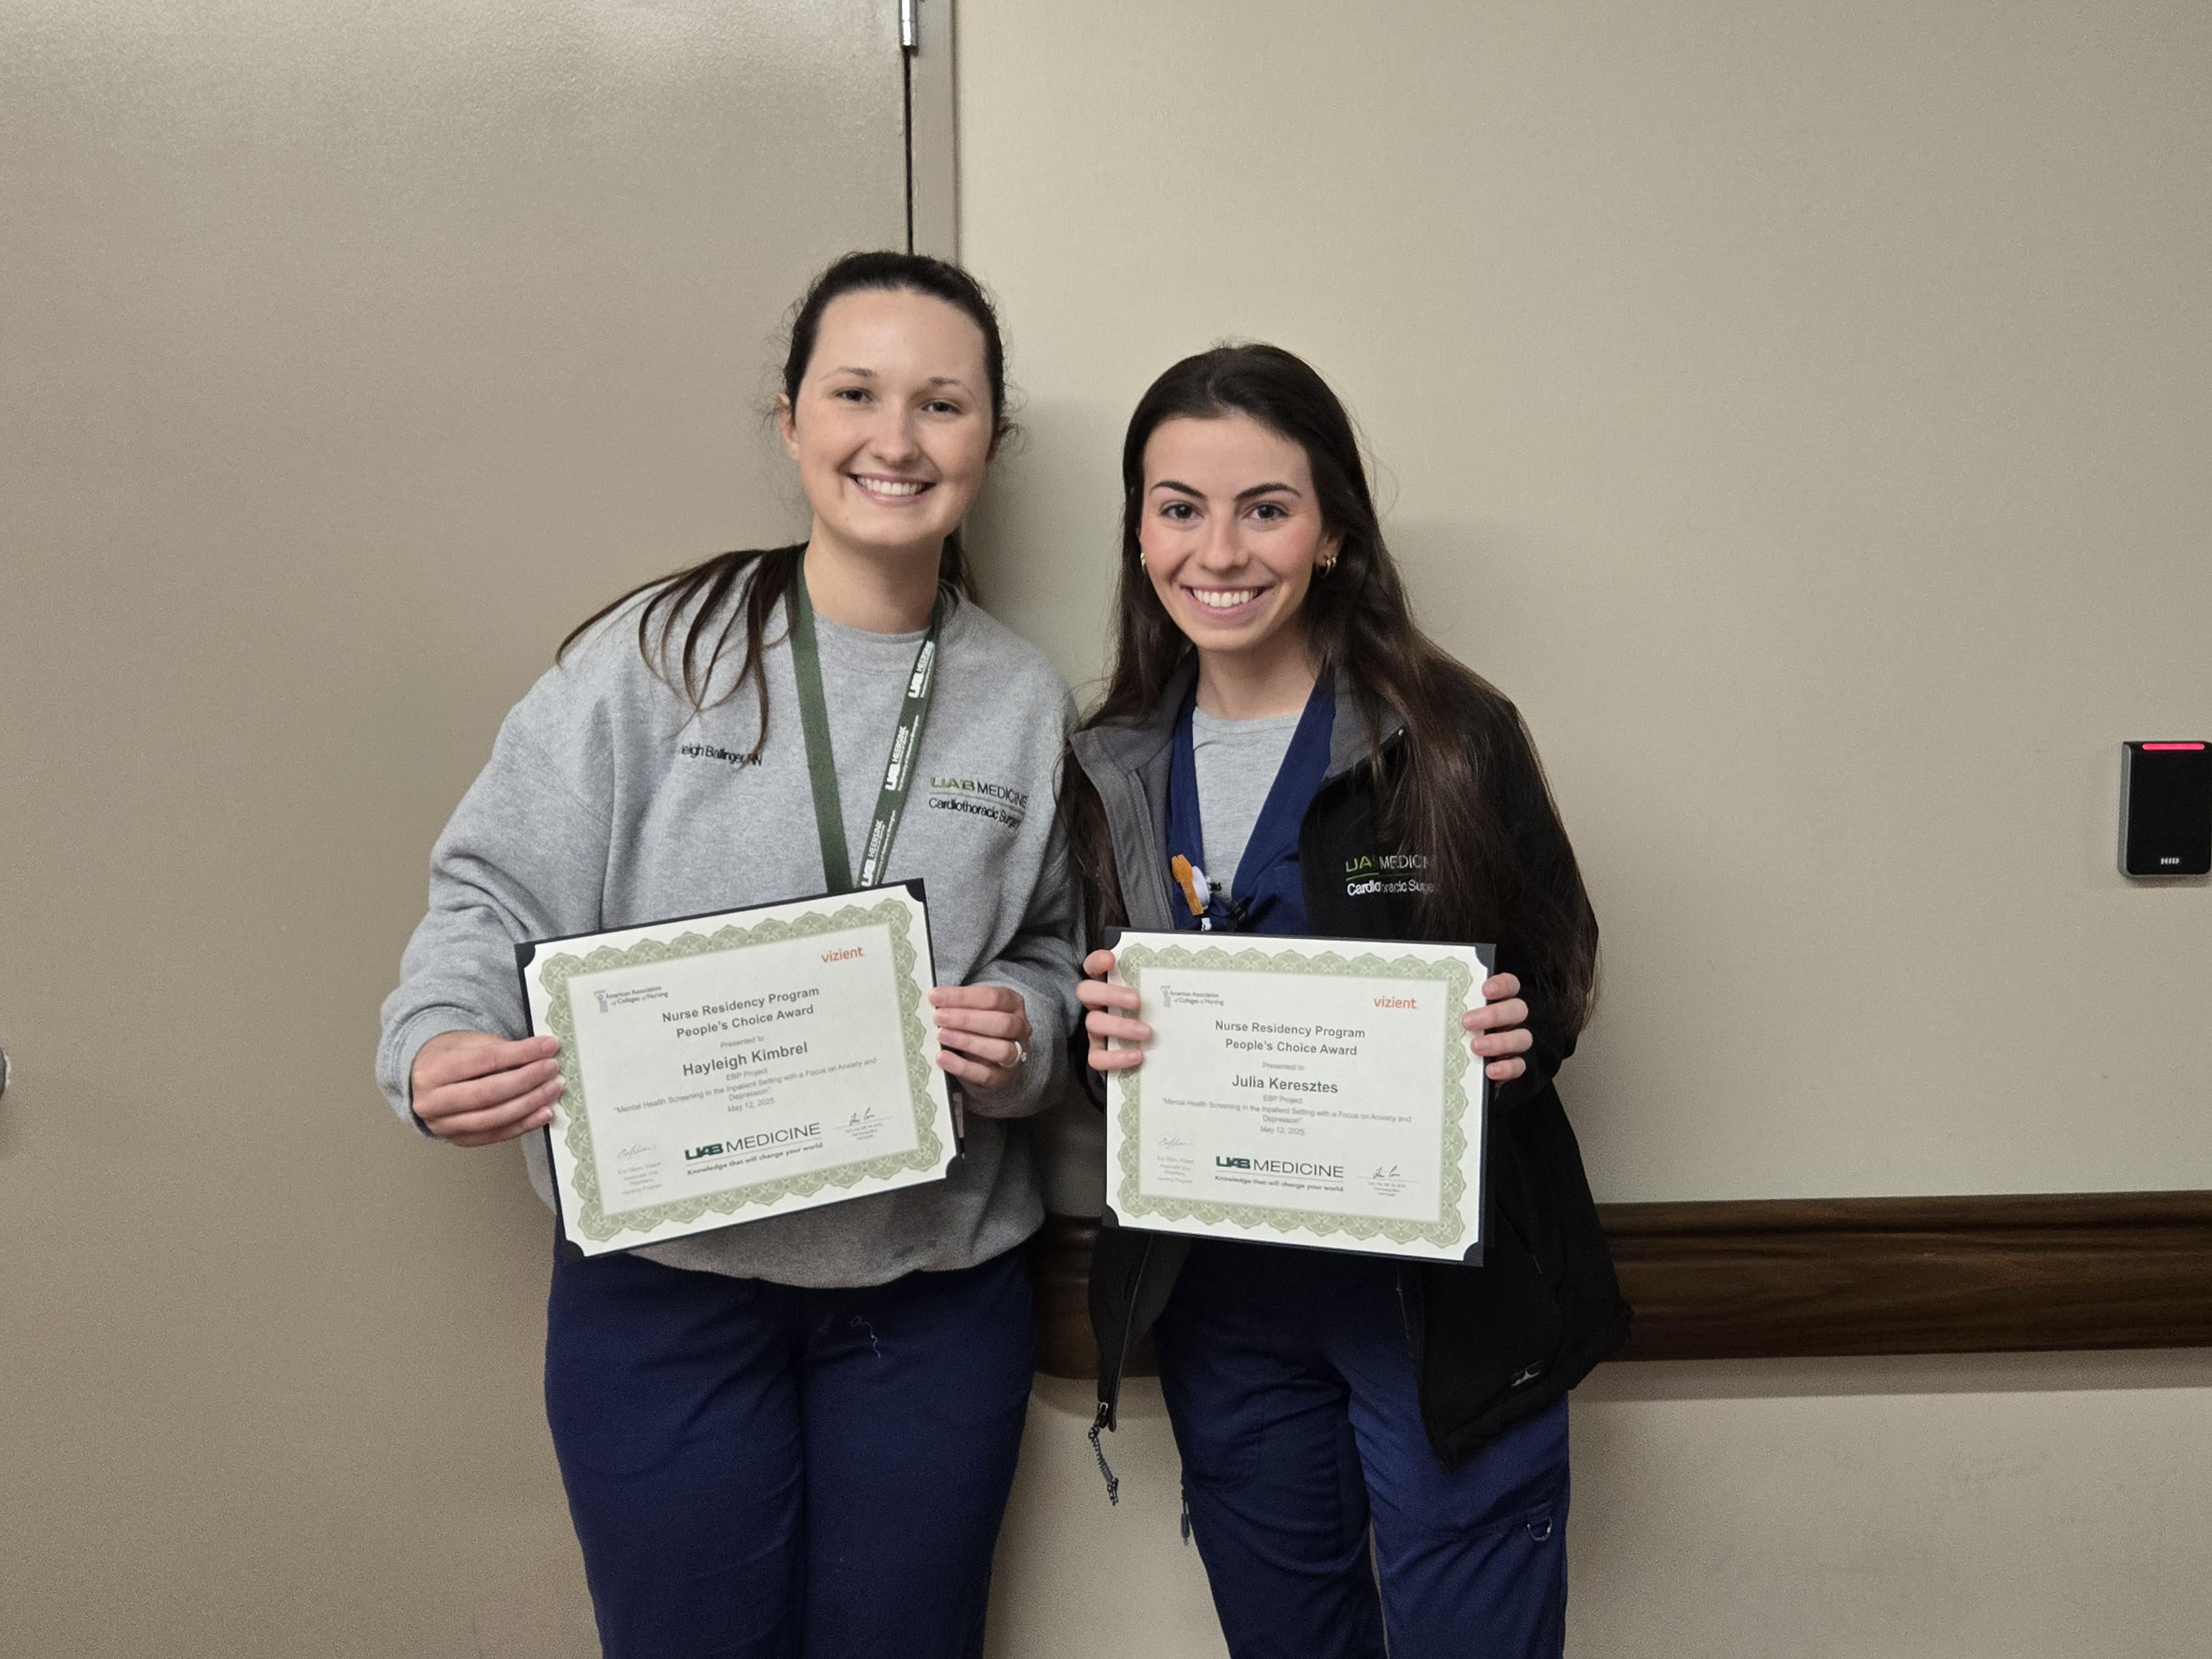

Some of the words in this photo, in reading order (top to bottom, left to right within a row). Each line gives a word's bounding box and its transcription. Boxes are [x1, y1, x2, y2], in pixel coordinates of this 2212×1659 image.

[908, 672, 924, 698] UAB
[885, 764, 900, 791] UAB
[930, 777, 975, 791] UAB
[977, 780, 1029, 808] MEDICINE
[929, 797, 999, 820] Cardiothoracic
[868, 820, 884, 857] HEERSINK
[861, 859, 876, 886] UAB
[821, 946, 864, 963] vizient
[662, 1009, 698, 1022] Nurse
[702, 998, 765, 1016] Residency
[769, 988, 819, 1004] Program
[1374, 996, 1416, 1009] vizient
[676, 1021, 728, 1038] People's
[732, 1013, 773, 1028] Choice
[776, 1004, 814, 1020] Award
[1215, 1020, 1248, 1032] Nurse
[1251, 1022, 1312, 1037] Residency
[1316, 1025, 1365, 1039] Program
[721, 1036, 756, 1048] Presented
[1225, 1038, 1273, 1052] People's
[1277, 1041, 1317, 1053] Choice
[1320, 1044, 1357, 1056] Award
[683, 1054, 747, 1076] Hayleigh
[752, 1041, 808, 1063] Kimbrel
[1262, 1061, 1296, 1071] Presented
[643, 1099, 666, 1108] Health
[668, 1092, 704, 1104] Screening
[727, 1081, 757, 1093] Inpatient
[758, 1076, 782, 1086] Setting
[784, 1072, 797, 1081] with
[806, 1068, 826, 1077] Focus
[838, 1061, 863, 1071] Anxiety
[864, 1057, 877, 1066] and
[726, 1072, 742, 1081] EBP
[743, 1067, 768, 1078] Project
[1232, 1074, 1264, 1088] Julia
[1269, 1077, 1338, 1093] Keresztes
[728, 1104, 744, 1113] May
[758, 1097, 775, 1107] 2025
[1279, 1095, 1303, 1105] Project
[1209, 1101, 1240, 1112] Screening
[1262, 1105, 1290, 1115] Inpatient
[1291, 1108, 1315, 1117] Setting
[1370, 1113, 1396, 1123] Anxiety
[684, 1143, 724, 1161] UAB
[726, 1122, 821, 1152] MEDICINE
[1288, 1127, 1305, 1135] 2025
[687, 1163, 727, 1176] Knowledge
[729, 1159, 744, 1167] that
[745, 1155, 757, 1164] will
[759, 1151, 784, 1161] change
[786, 1147, 801, 1156] your
[803, 1141, 823, 1152] world
[1215, 1156, 1251, 1169] UAB
[1253, 1159, 1344, 1178] MEDICINE
[1214, 1175, 1251, 1184] Knowledge
[1253, 1177, 1266, 1185] that
